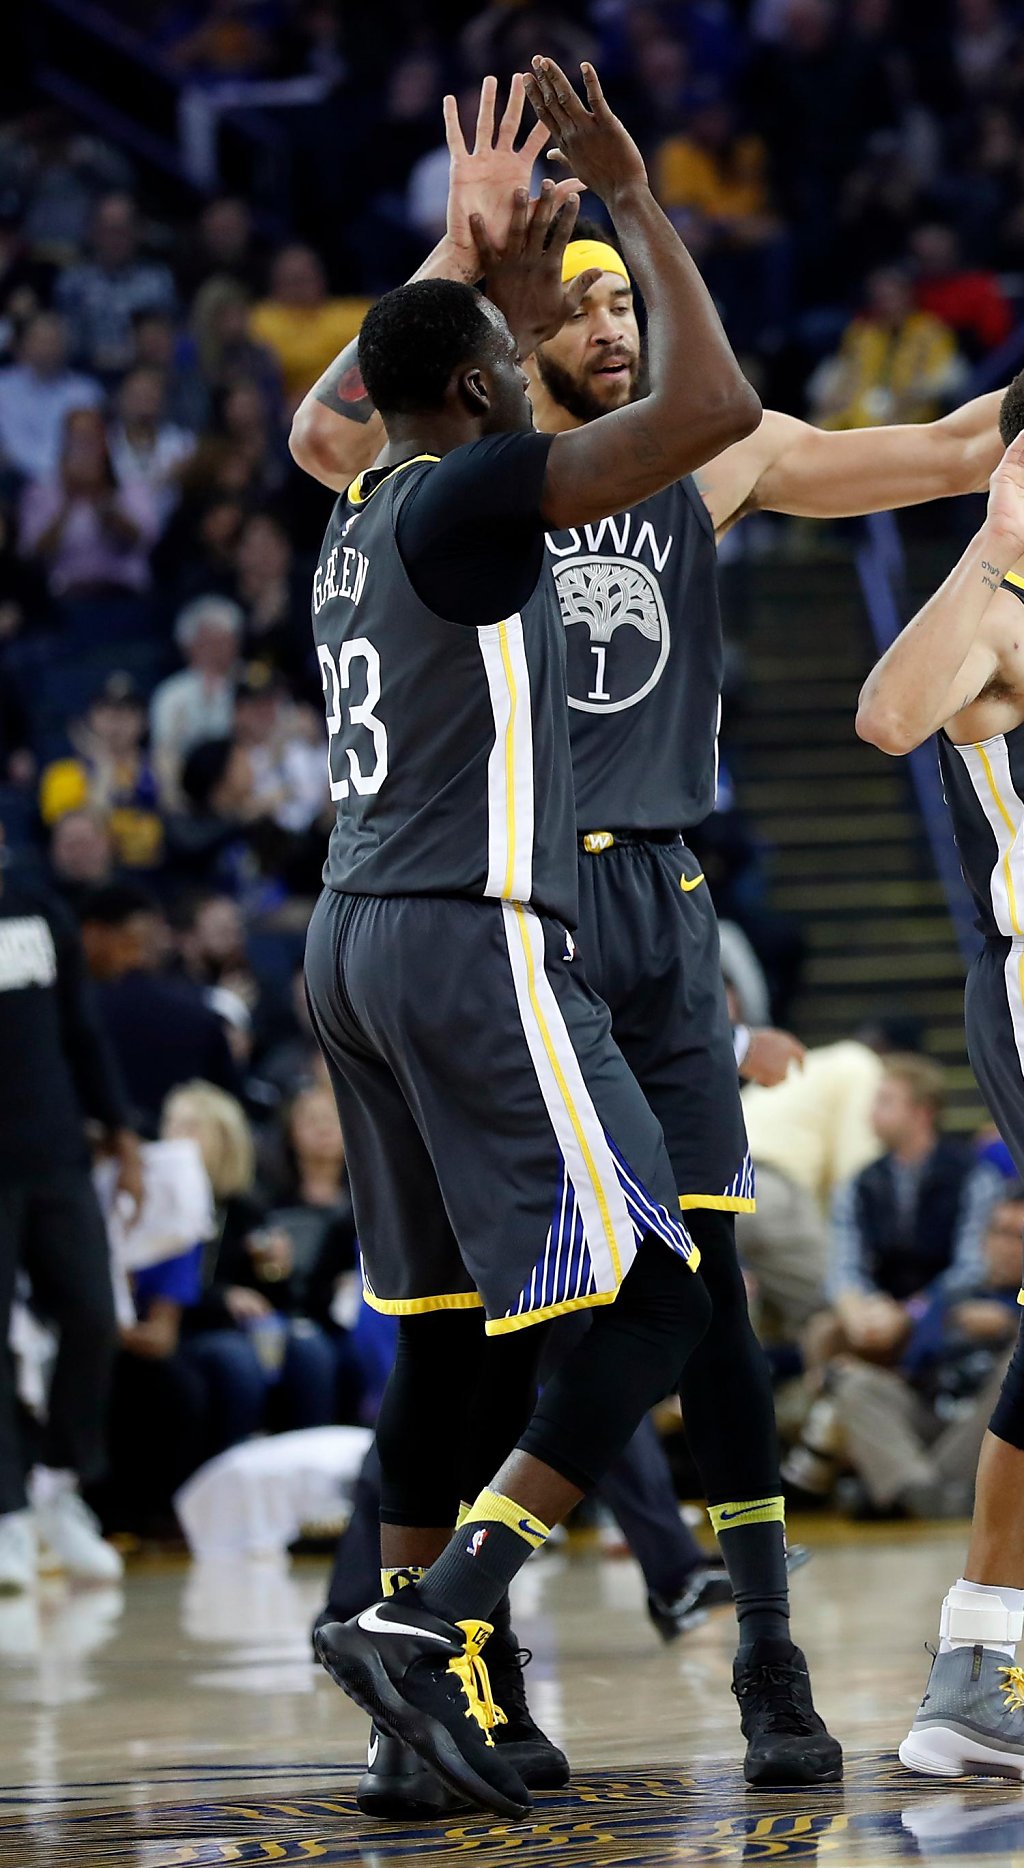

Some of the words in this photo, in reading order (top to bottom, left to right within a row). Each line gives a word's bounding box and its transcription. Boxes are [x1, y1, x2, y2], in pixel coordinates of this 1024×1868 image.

[544, 513, 673, 573] OWN
[589, 647, 611, 700] 1
[316, 637, 388, 801] 23
